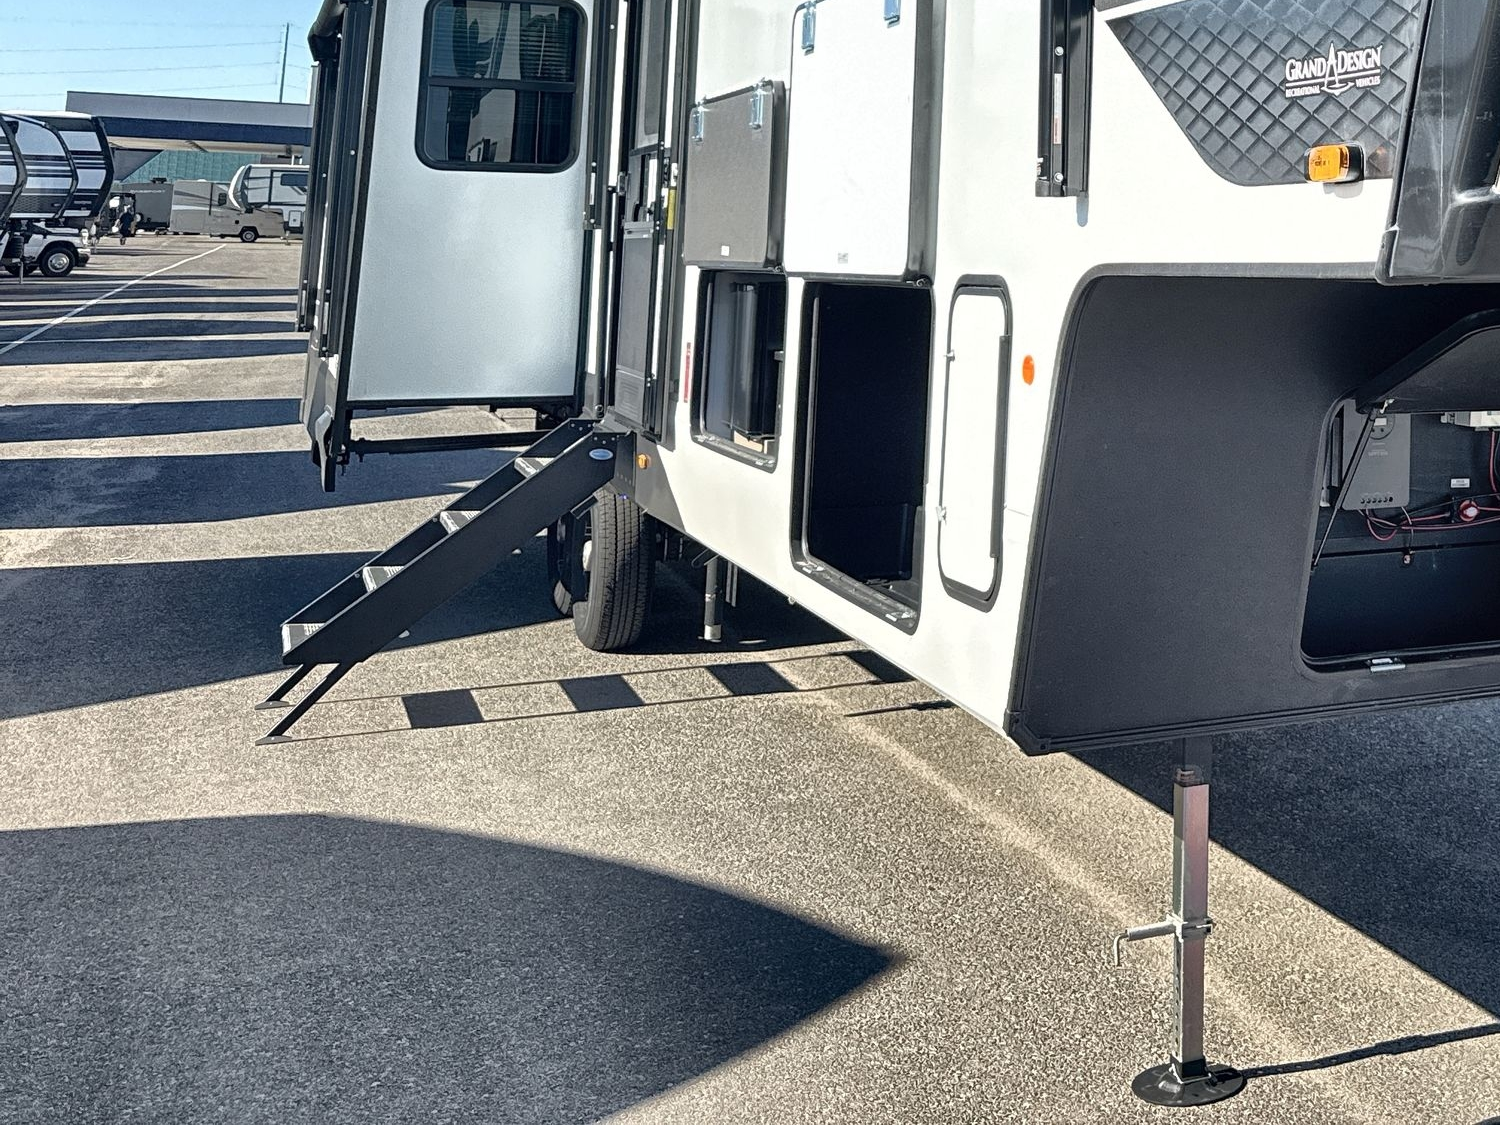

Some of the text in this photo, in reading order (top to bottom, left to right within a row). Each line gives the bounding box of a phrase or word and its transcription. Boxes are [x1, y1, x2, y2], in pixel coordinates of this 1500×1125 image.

[1285, 44, 1383, 81] GRAND DESIGN
[1355, 75, 1381, 88] VEHICLES
